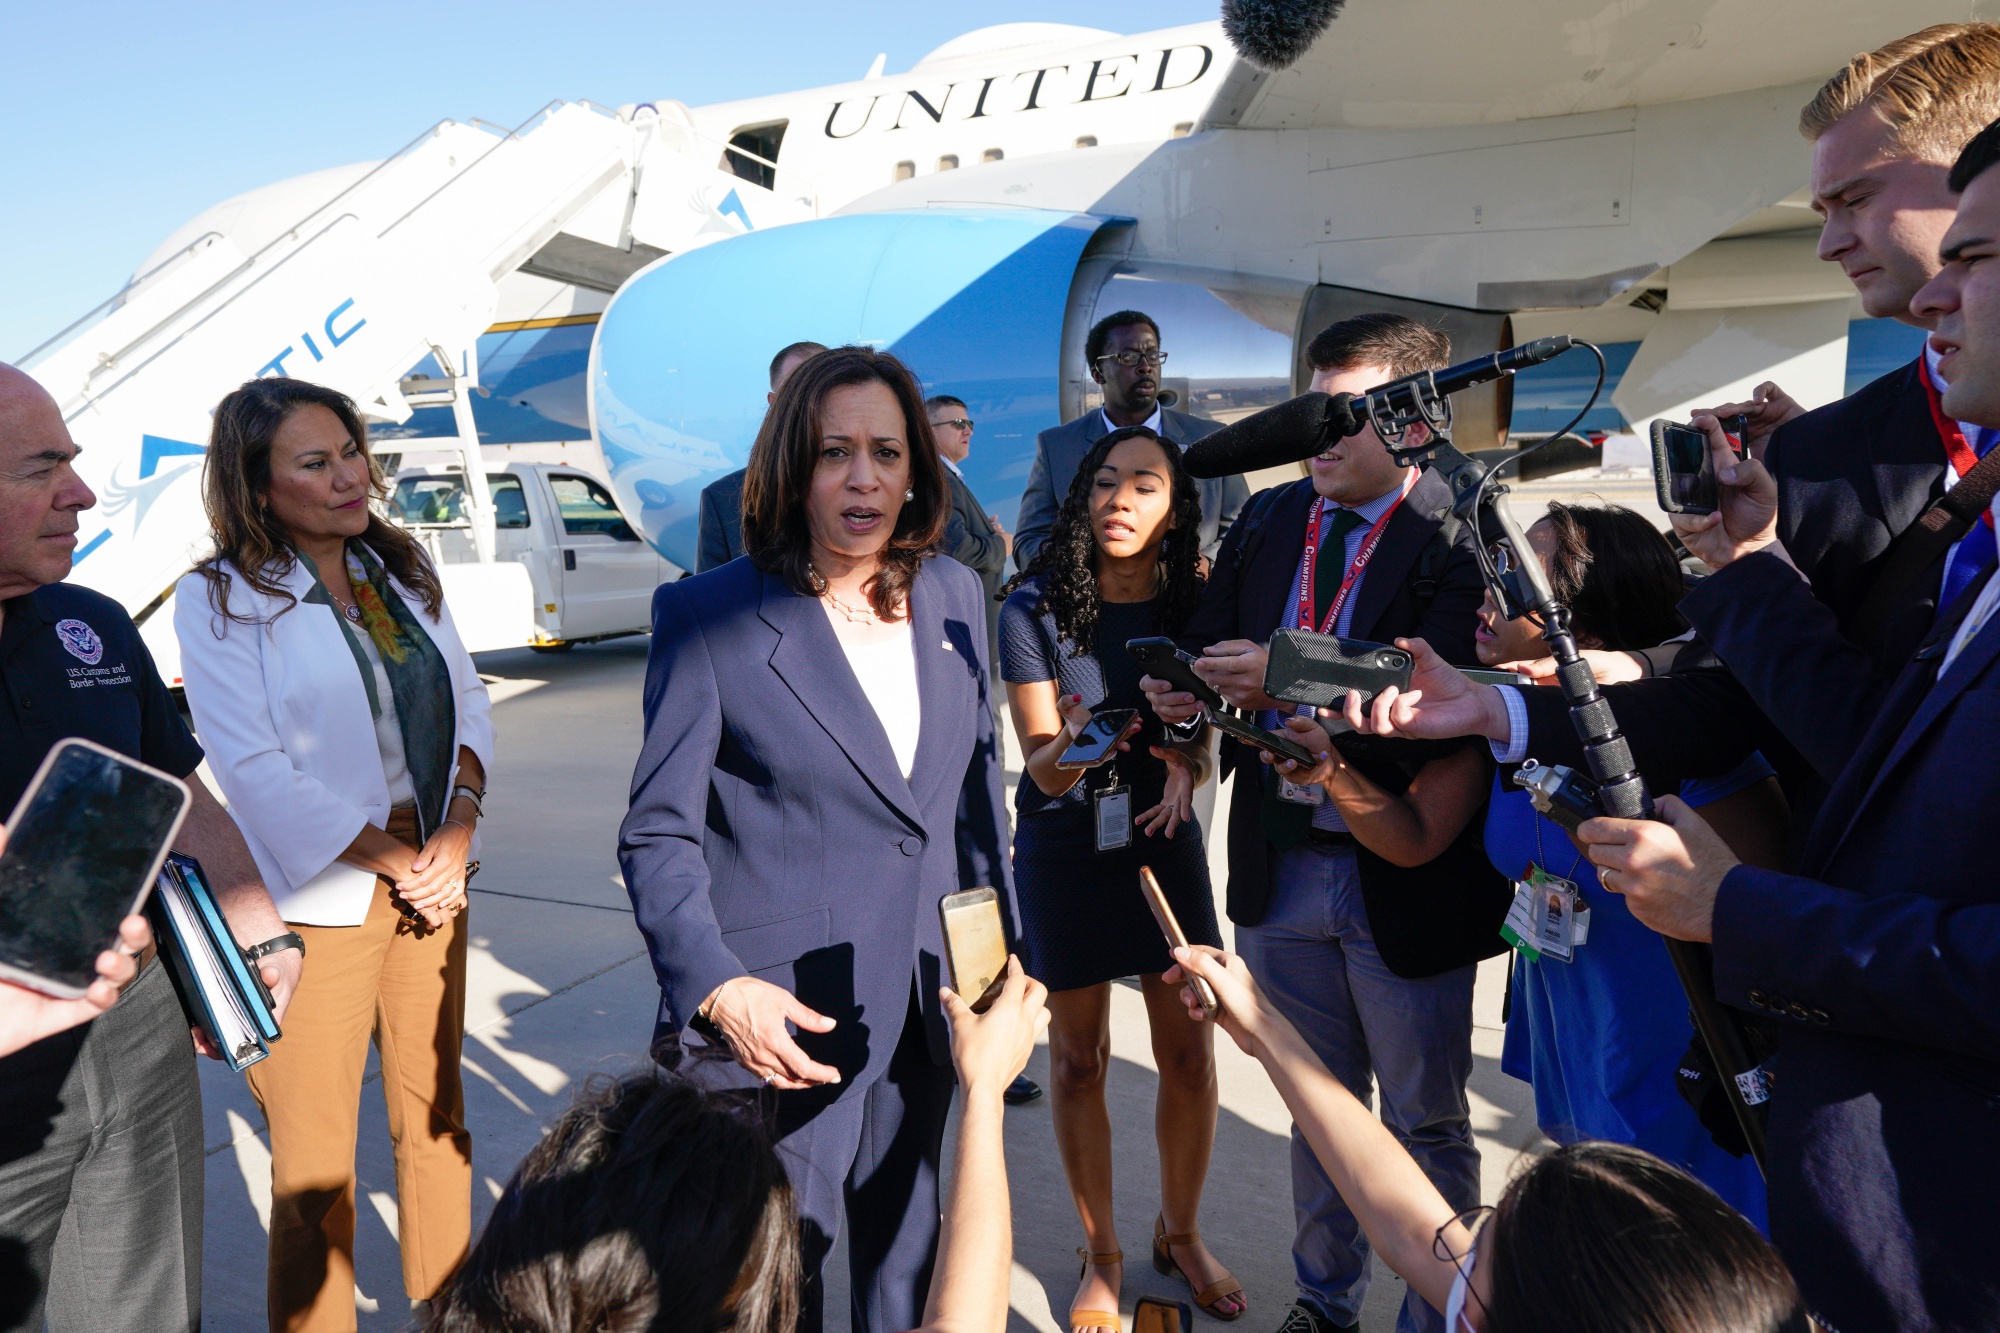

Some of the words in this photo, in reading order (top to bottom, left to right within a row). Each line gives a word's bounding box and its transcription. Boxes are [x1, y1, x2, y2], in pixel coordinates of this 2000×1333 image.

[824, 44, 1213, 139] UNITED
[1301, 545, 1315, 602] CHAMPIONS
[111, 662, 126, 674] and
[1516, 938, 1525, 948] P
